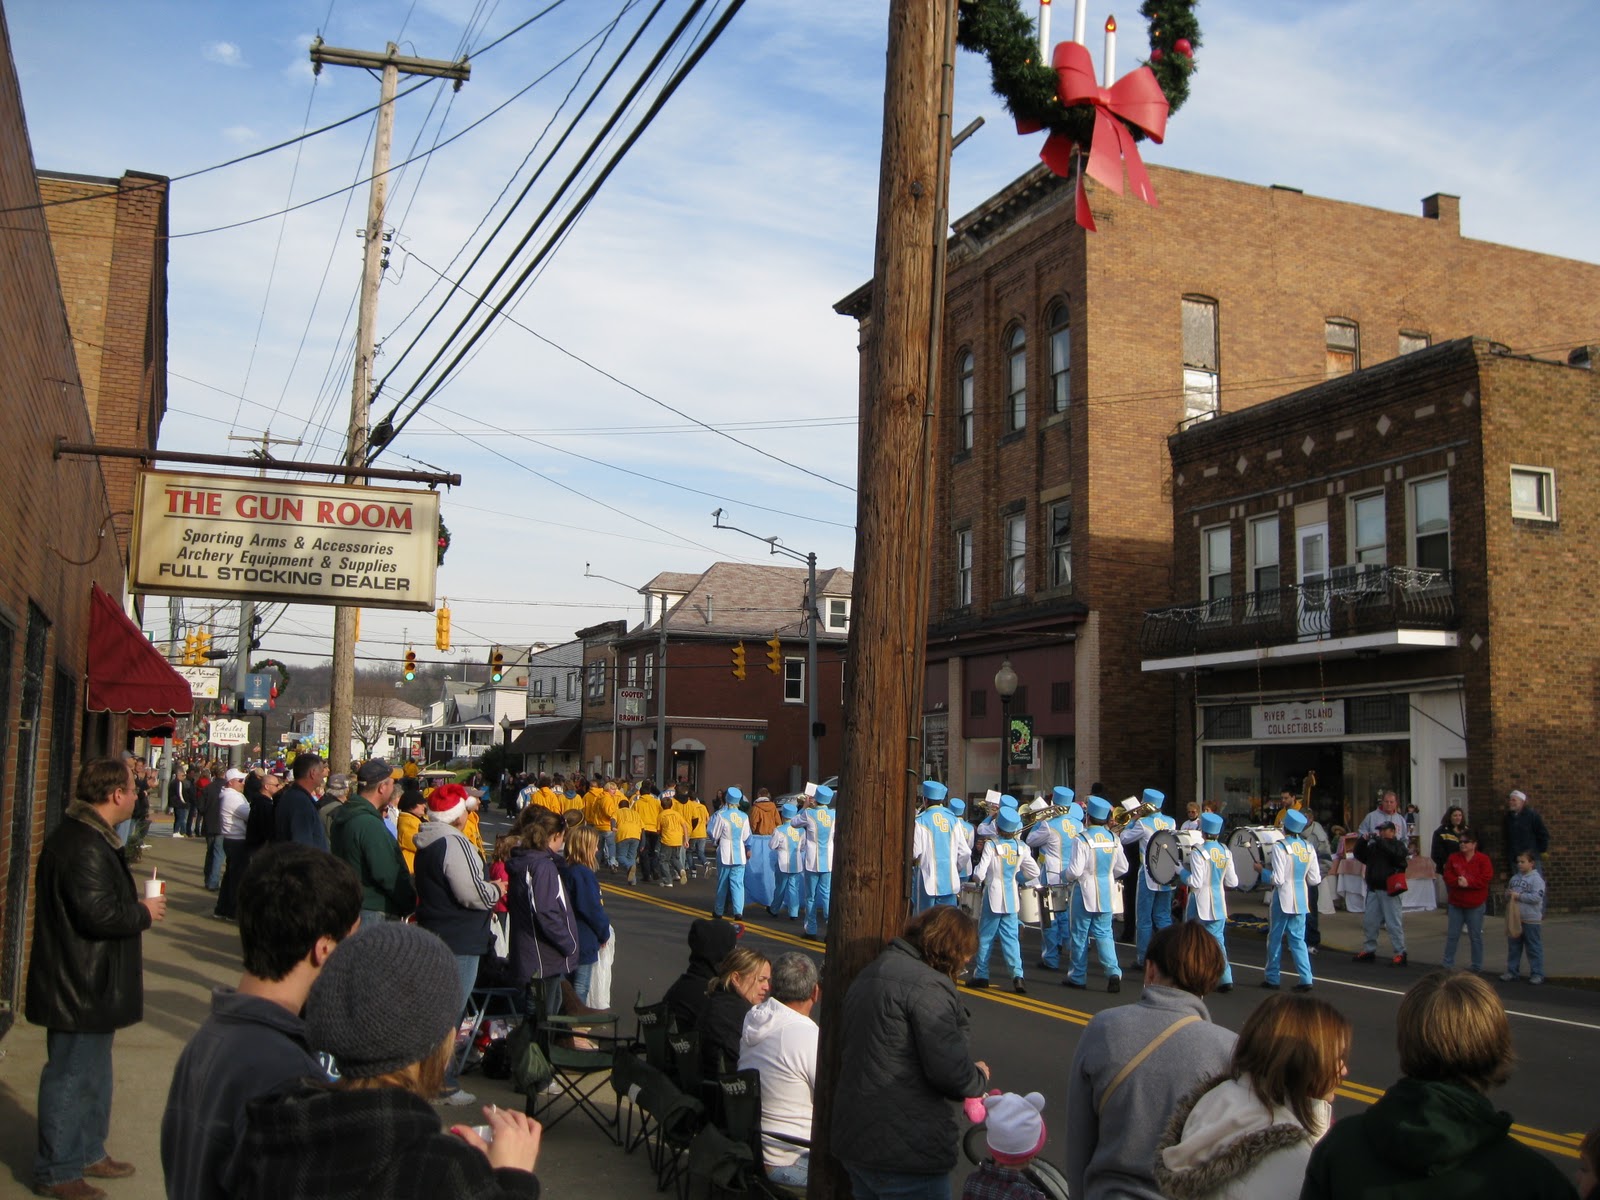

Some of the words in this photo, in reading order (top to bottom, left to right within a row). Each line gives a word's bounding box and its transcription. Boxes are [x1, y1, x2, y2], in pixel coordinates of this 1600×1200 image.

[165, 489, 222, 516] THE
[235, 495, 304, 525] GUN
[317, 500, 413, 530] ROOM
[182, 528, 244, 548] Sporting
[250, 533, 287, 548] Arms
[294, 536, 305, 549] &
[312, 537, 394, 555] Accessories
[176, 546, 234, 565] Archery
[240, 550, 314, 568] Equipment
[320, 555, 332, 569] &
[338, 557, 397, 573] Supplies
[159, 562, 208, 579] FULL
[217, 566, 322, 585] STOCKING
[331, 573, 411, 591] DEALER
[621, 691, 644, 699] COOTER
[215, 721, 243, 732] Chester
[730, 812, 743, 829] OG
[817, 809, 831, 828] OG
[932, 812, 949, 833] OG
[1061, 818, 1077, 839] OG
[787, 825, 800, 842] OG
[1001, 843, 1017, 865] OG
[1210, 847, 1226, 868] OG
[1291, 841, 1308, 863] OG
